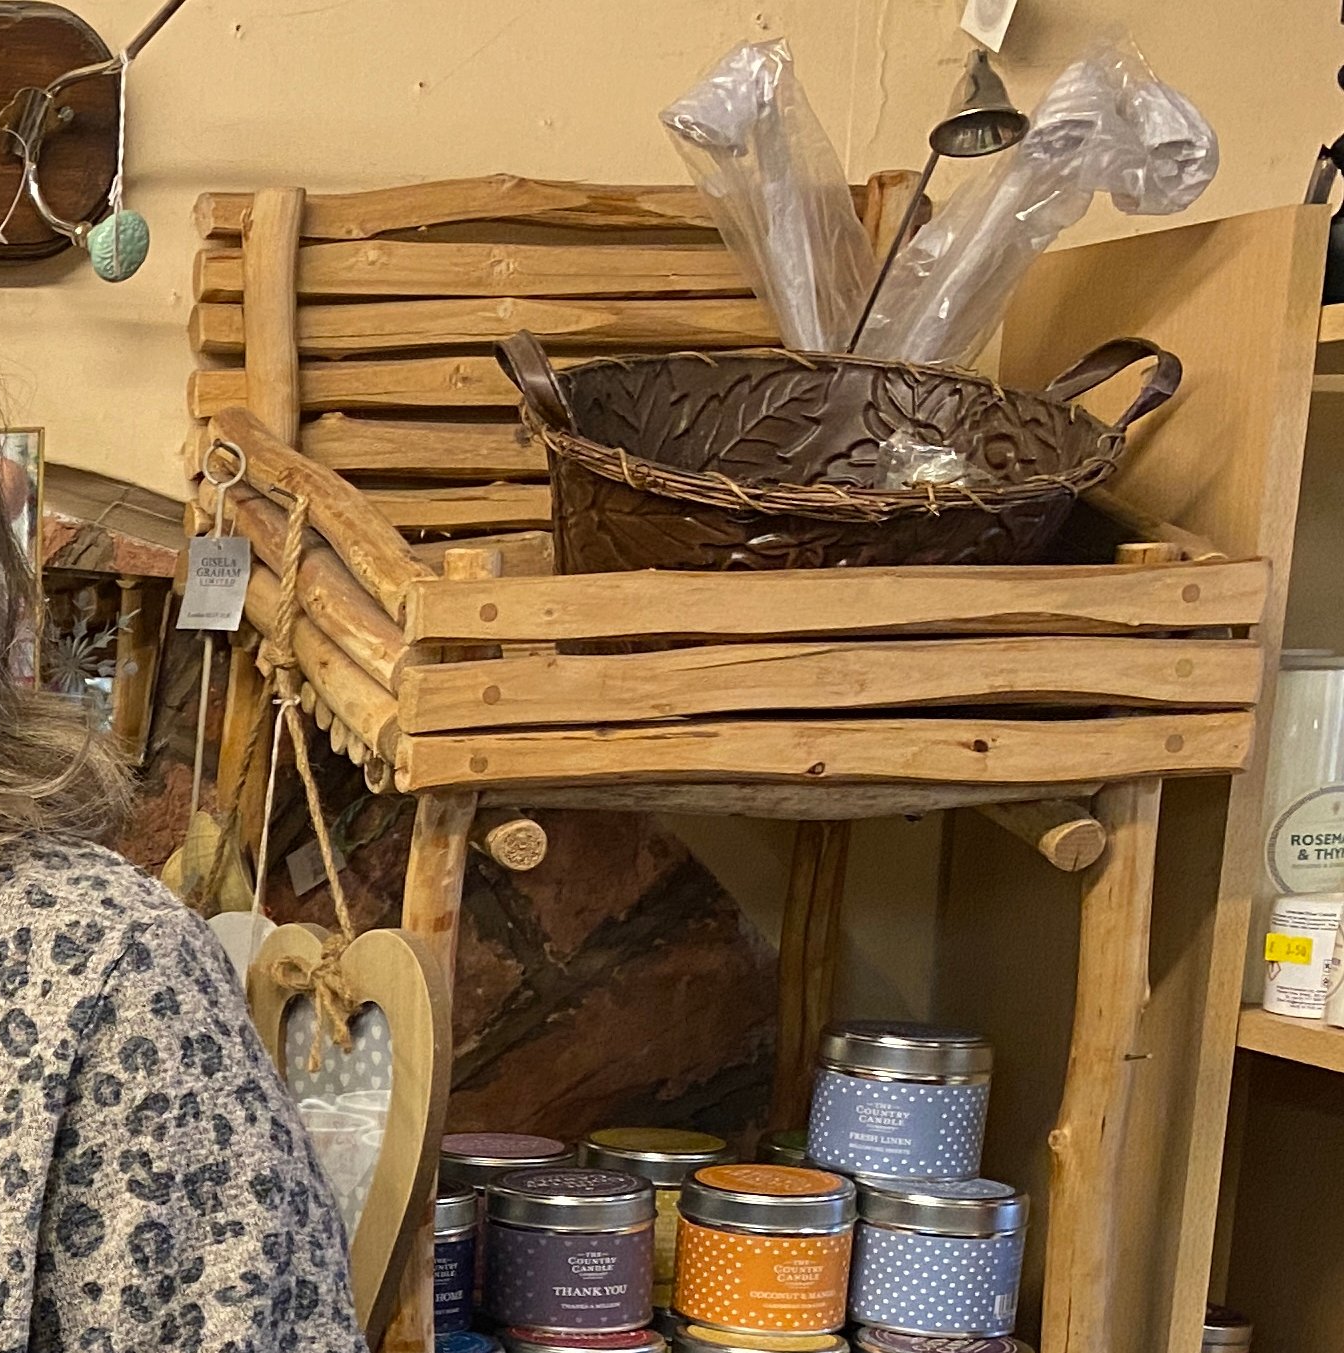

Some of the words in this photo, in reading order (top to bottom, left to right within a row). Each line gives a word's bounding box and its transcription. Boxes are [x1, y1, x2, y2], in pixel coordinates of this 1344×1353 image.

[196, 567, 242, 578] GRAHAM
[1297, 849, 1310, 861] &
[567, 1256, 617, 1266] COUNTRY
[571, 1264, 615, 1274] CANDLE
[776, 1273, 821, 1283] CANDLE
[552, 1286, 602, 1298] THANK
[603, 1284, 628, 1295] YOU
